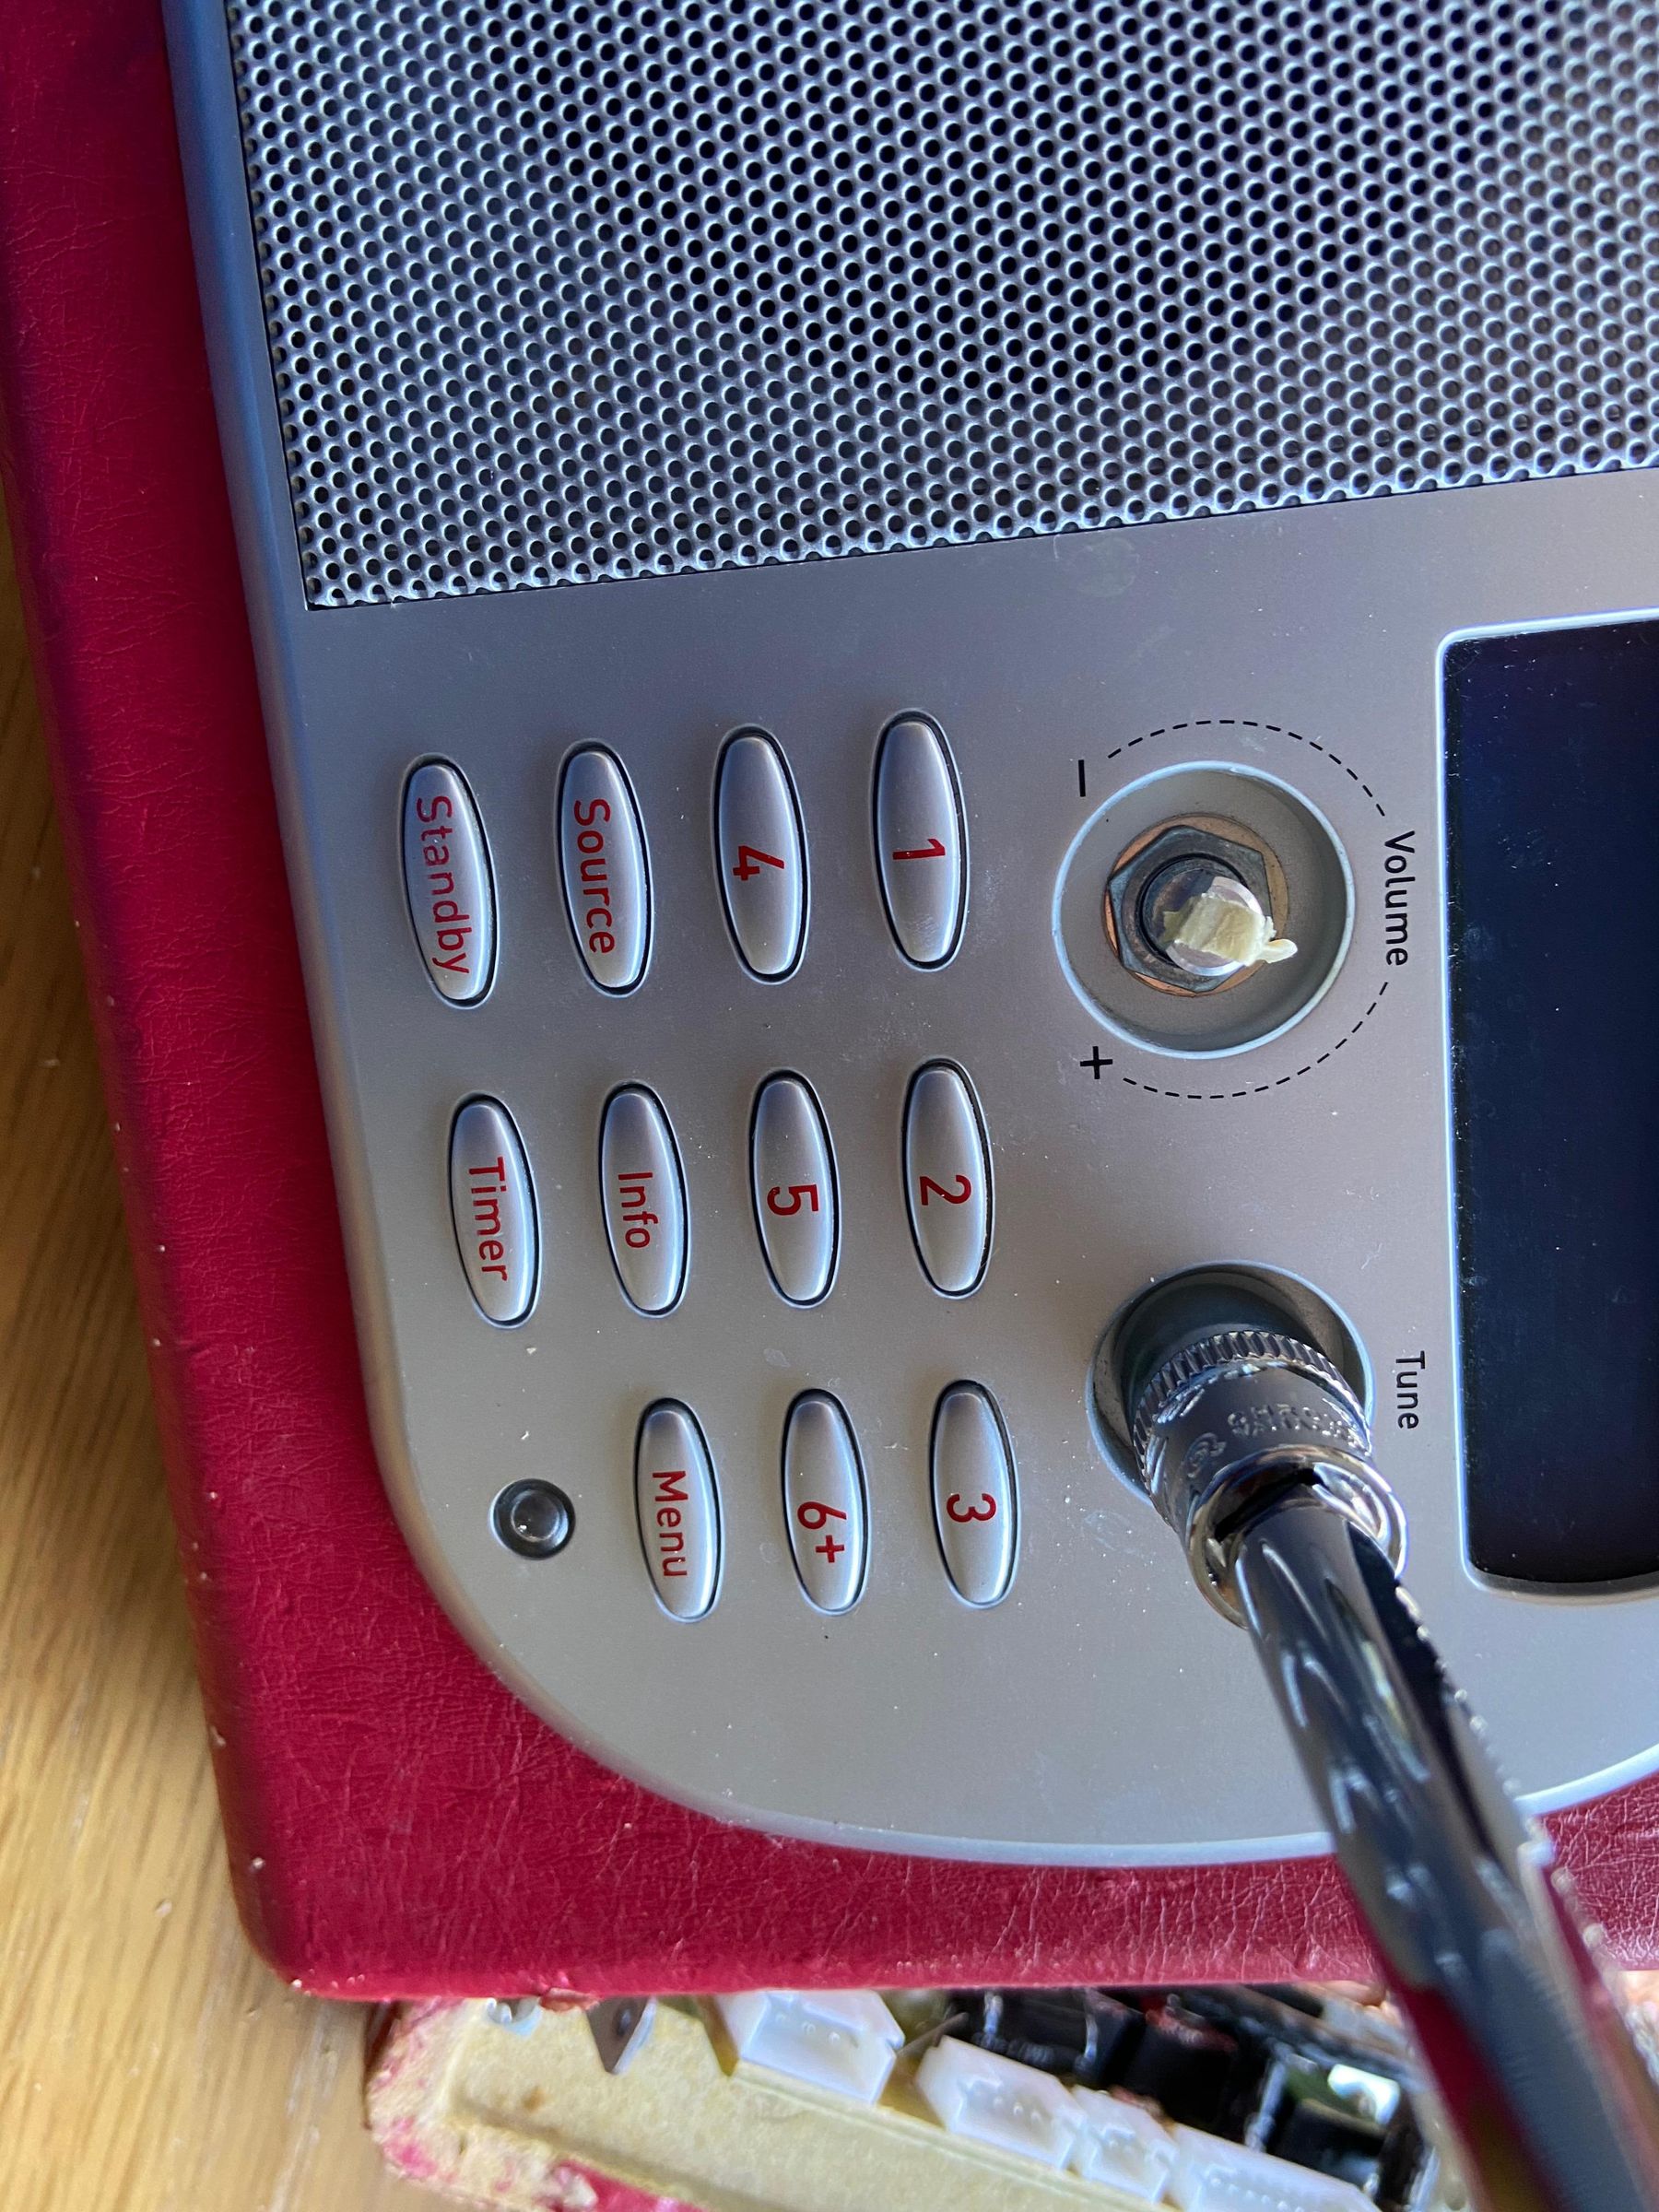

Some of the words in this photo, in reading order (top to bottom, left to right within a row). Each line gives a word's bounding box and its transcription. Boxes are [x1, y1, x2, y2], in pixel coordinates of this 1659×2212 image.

[416, 795, 471, 974] Standby
[573, 798, 616, 955] Source
[732, 844, 785, 882] 4
[892, 838, 945, 861] 1
[1384, 830, 1416, 967] Volume
[468, 1156, 509, 1282] Timer
[618, 1171, 656, 1249] Info
[766, 1183, 819, 1218] 5
[919, 1174, 972, 1206] 2
[1395, 1350, 1426, 1430] Tune
[652, 1470, 688, 1578] Menu
[795, 1500, 847, 1564] 6+
[946, 1492, 996, 1524] 3
